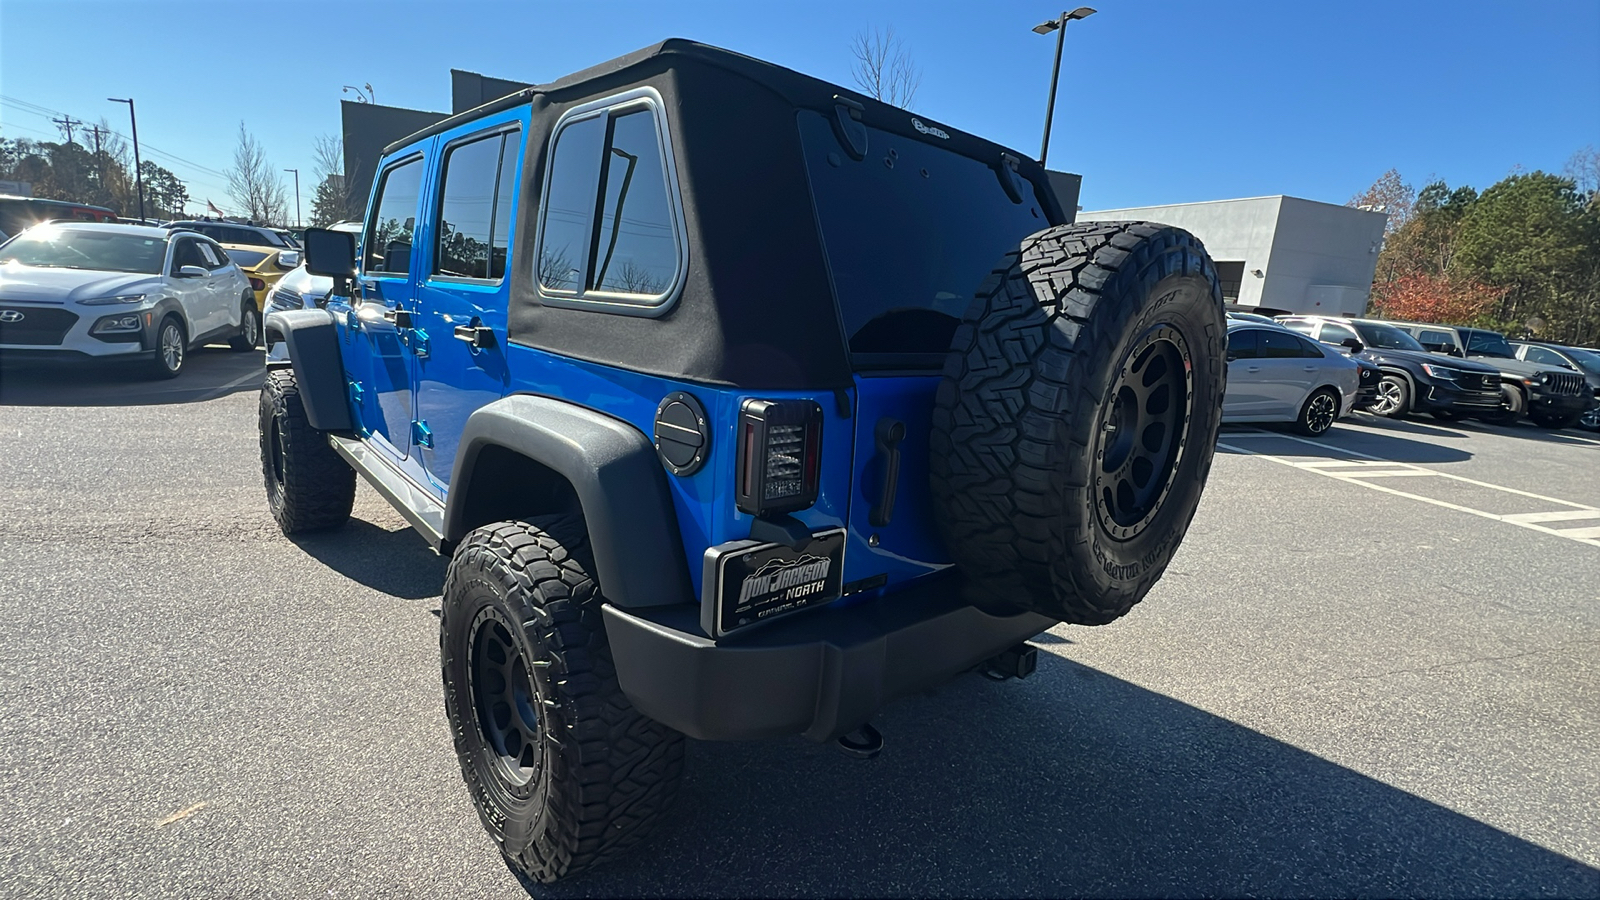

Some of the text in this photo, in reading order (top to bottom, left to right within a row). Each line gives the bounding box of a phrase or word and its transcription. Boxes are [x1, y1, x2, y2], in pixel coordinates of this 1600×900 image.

[738, 560, 831, 605] DON JACKSON
[785, 580, 825, 600] NORTH
